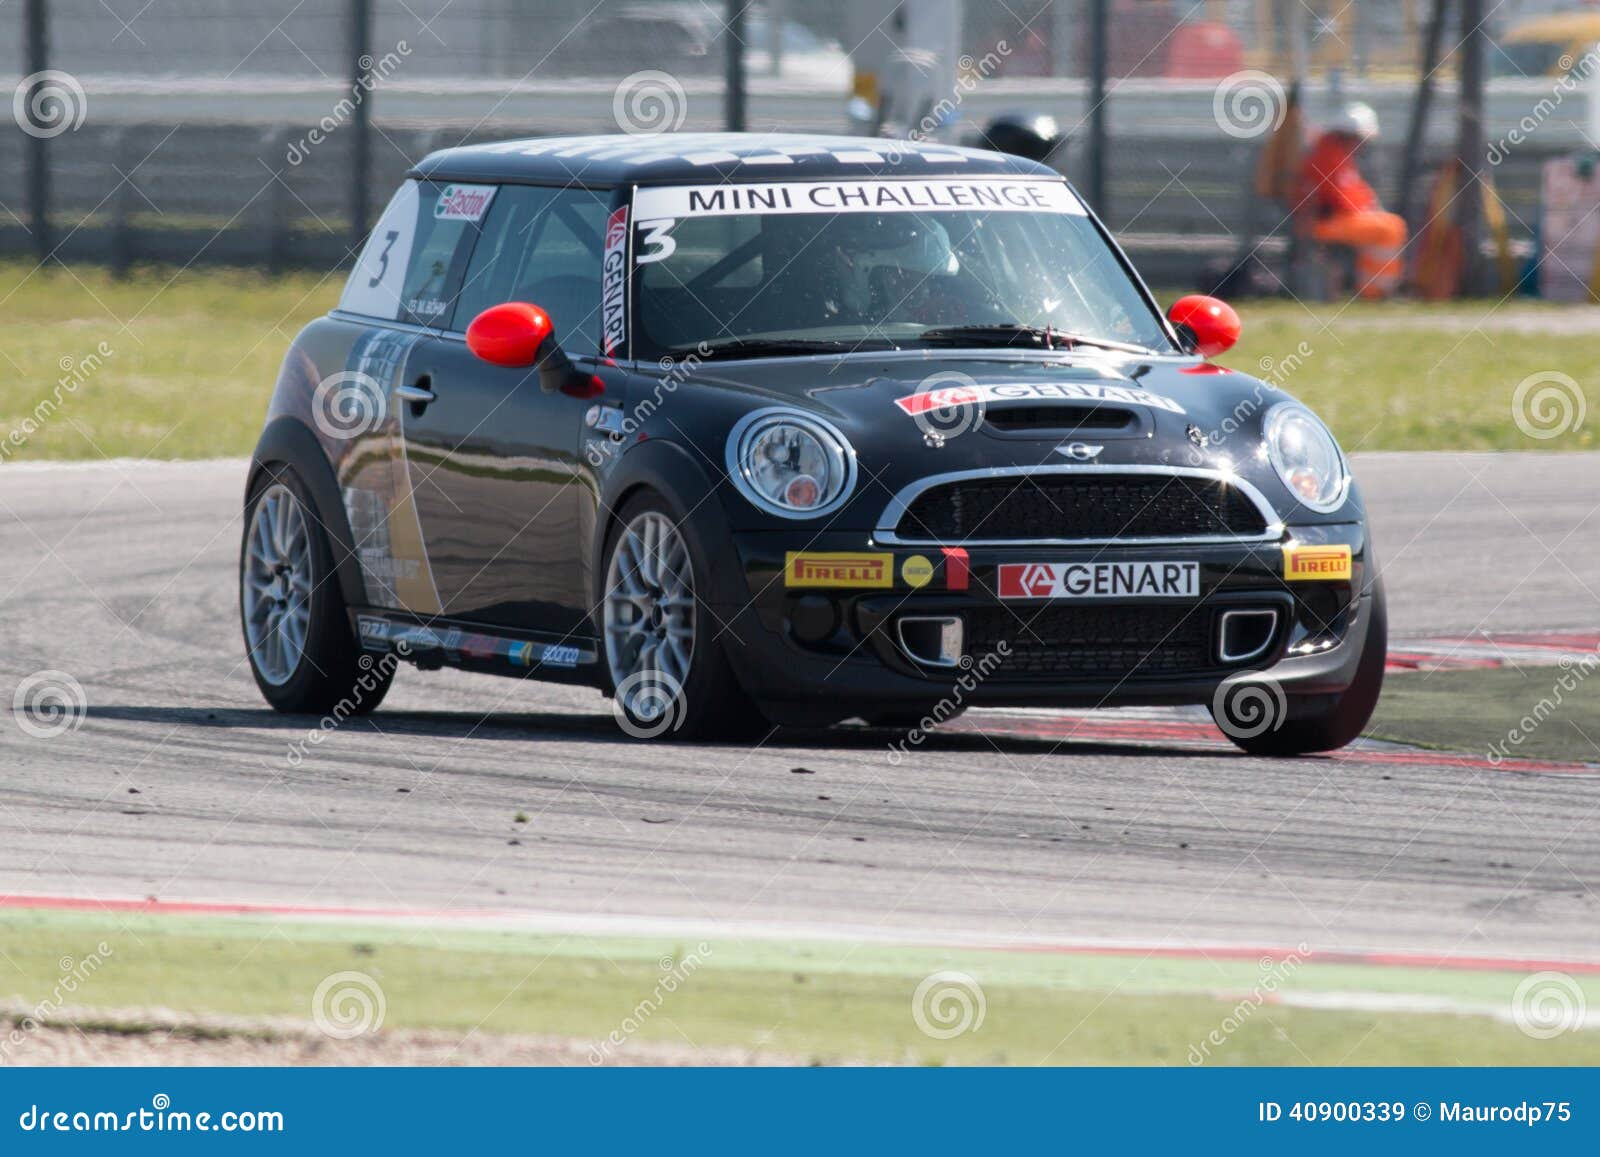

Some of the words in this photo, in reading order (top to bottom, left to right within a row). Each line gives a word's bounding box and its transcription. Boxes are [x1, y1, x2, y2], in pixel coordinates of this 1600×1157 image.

[689, 187, 793, 211] MINI
[808, 186, 1052, 208] CHALLENGE
[636, 218, 677, 264] 3
[368, 230, 400, 288] 3
[604, 250, 625, 348] GENART
[794, 559, 884, 581] PIRELLI
[1291, 552, 1347, 573] PIRELLI
[1063, 564, 1196, 595] GENART
